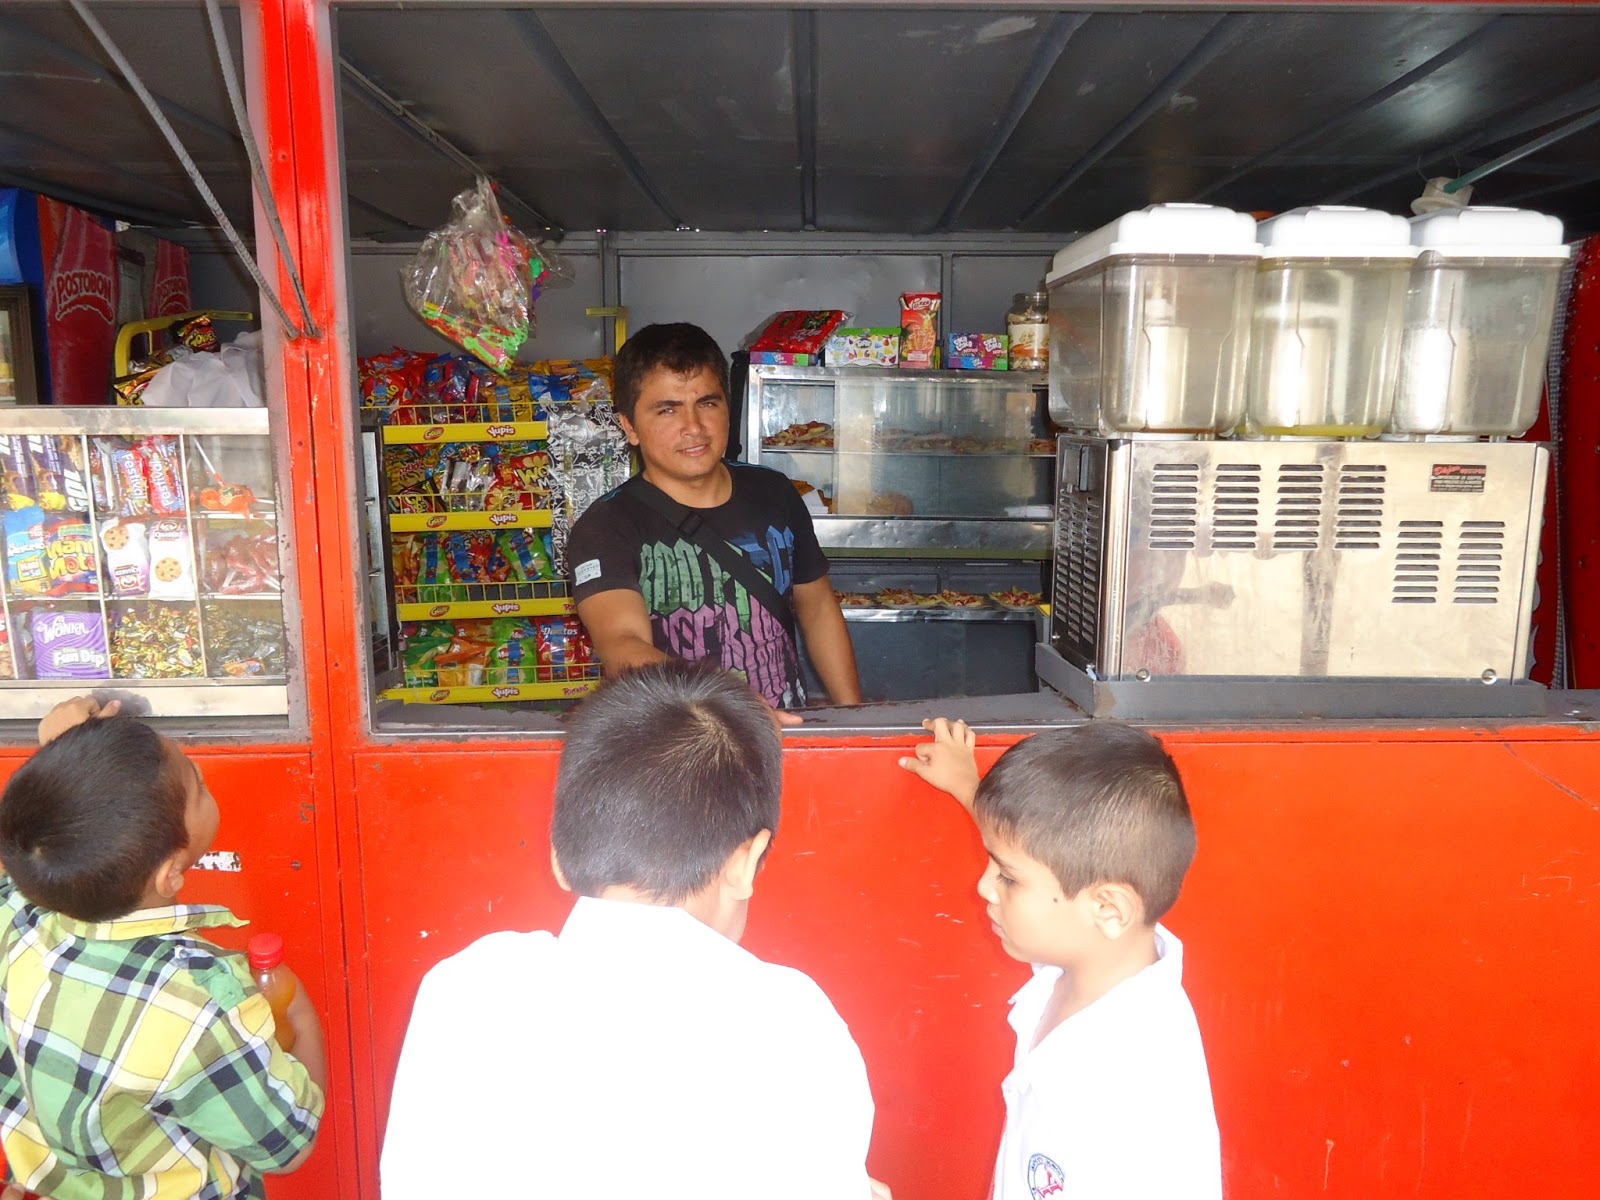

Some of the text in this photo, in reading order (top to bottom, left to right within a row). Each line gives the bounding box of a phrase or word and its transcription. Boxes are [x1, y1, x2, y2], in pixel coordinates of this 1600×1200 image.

[56, 271, 113, 307] POSTOBON
[156, 277, 189, 304] POSTOBON
[488, 425, 515, 438] Yupis
[122, 453, 147, 499] Festival
[148, 458, 174, 507] Festival
[490, 513, 517, 525] Yupis
[492, 603, 519, 614] Yupis
[53, 650, 105, 669] Fun Dip
[492, 686, 519, 698] Yupis
